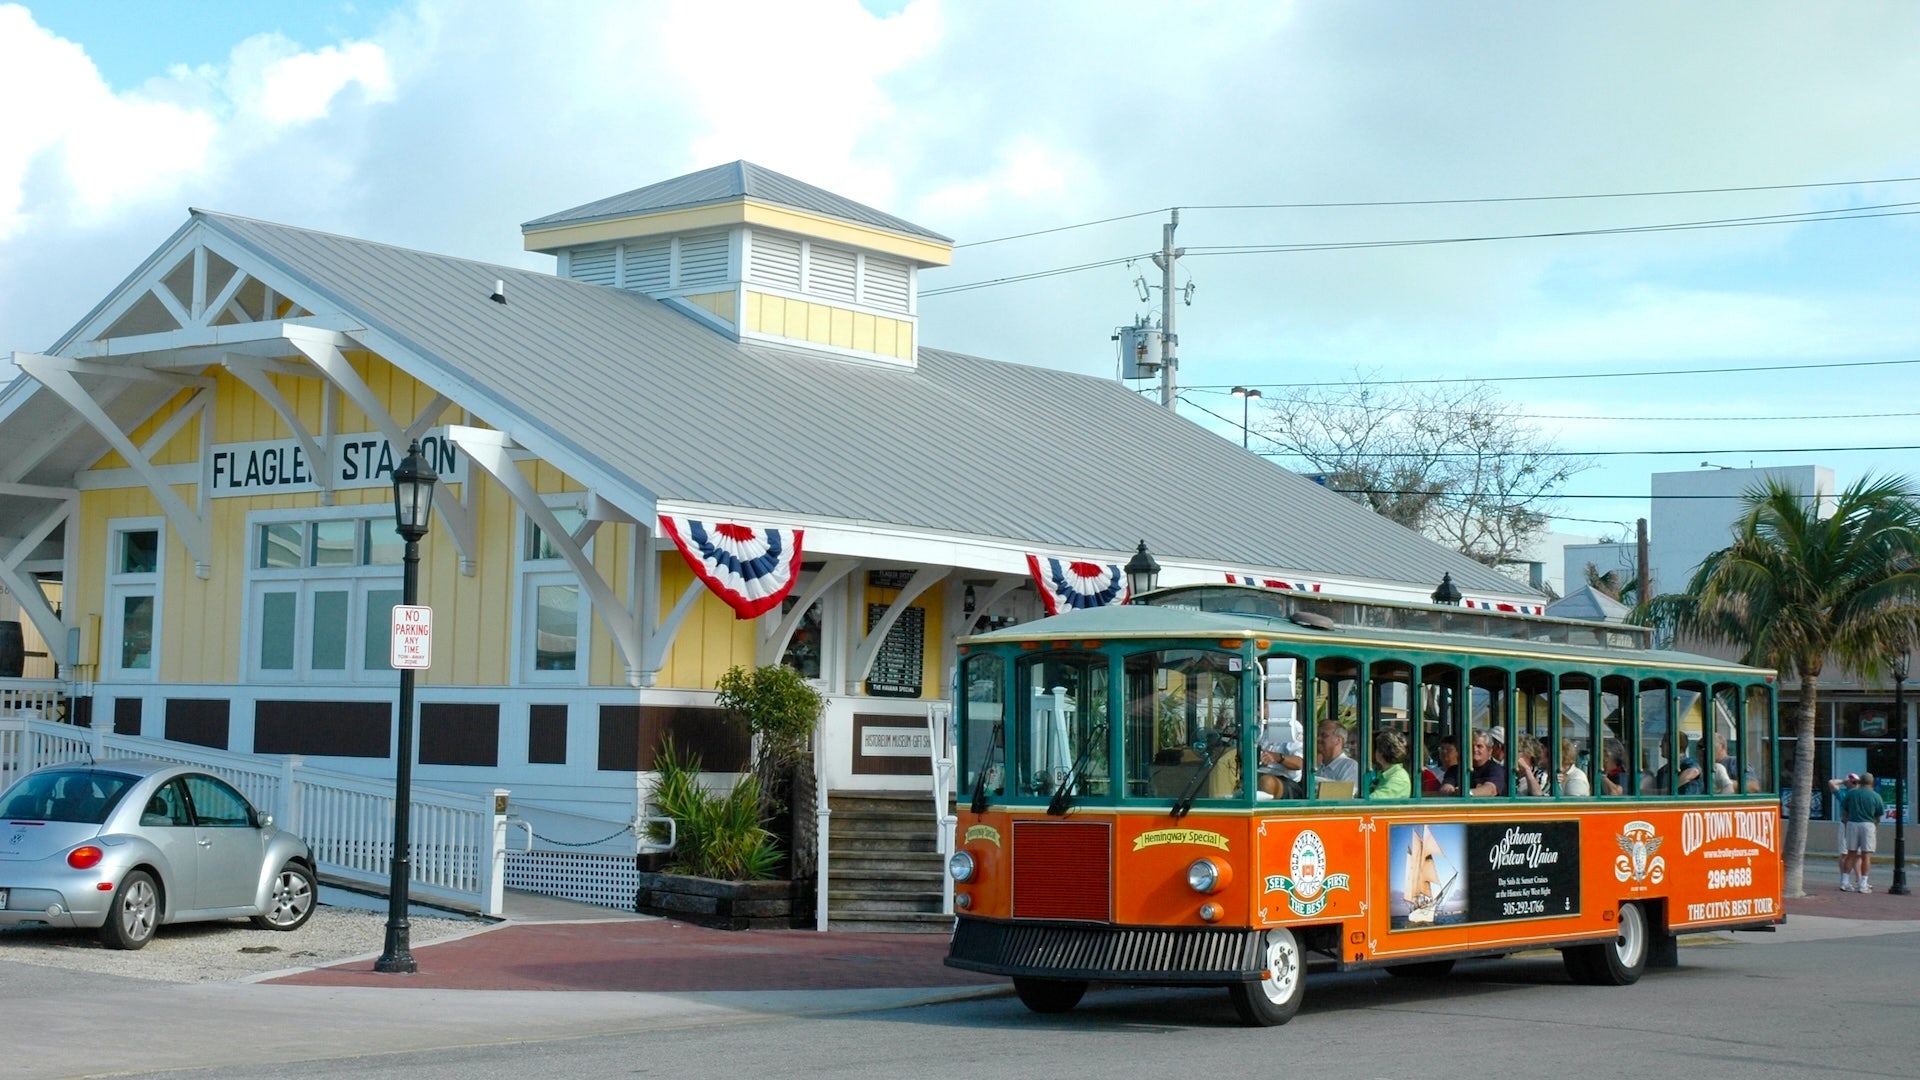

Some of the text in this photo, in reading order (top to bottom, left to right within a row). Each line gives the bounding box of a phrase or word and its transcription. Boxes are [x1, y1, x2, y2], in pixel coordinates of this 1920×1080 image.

[213, 436, 456, 489] FLAGLE STAON
[405, 610, 420, 622] NO
[395, 623, 429, 636] PARKING
[404, 636, 419, 645] ANY
[404, 645, 420, 654] TIME
[891, 734, 911, 748] MUSEUM
[912, 734, 923, 748] GIFT
[1144, 831, 1218, 845] Hemingway Special
[1500, 826, 1542, 854] Schooner
[1681, 811, 1776, 857] OLD TOWN TROLLEY
[1489, 843, 1559, 871] Western Union
[1703, 847, 1760, 860] www.trolleytours.com
[1269, 875, 1347, 889] SEE FIRST
[1290, 895, 1326, 915] THE BEST
[1502, 900, 1545, 916] 305-292-1766
[1687, 897, 1773, 921] THE CITY'S BEST TOUR
